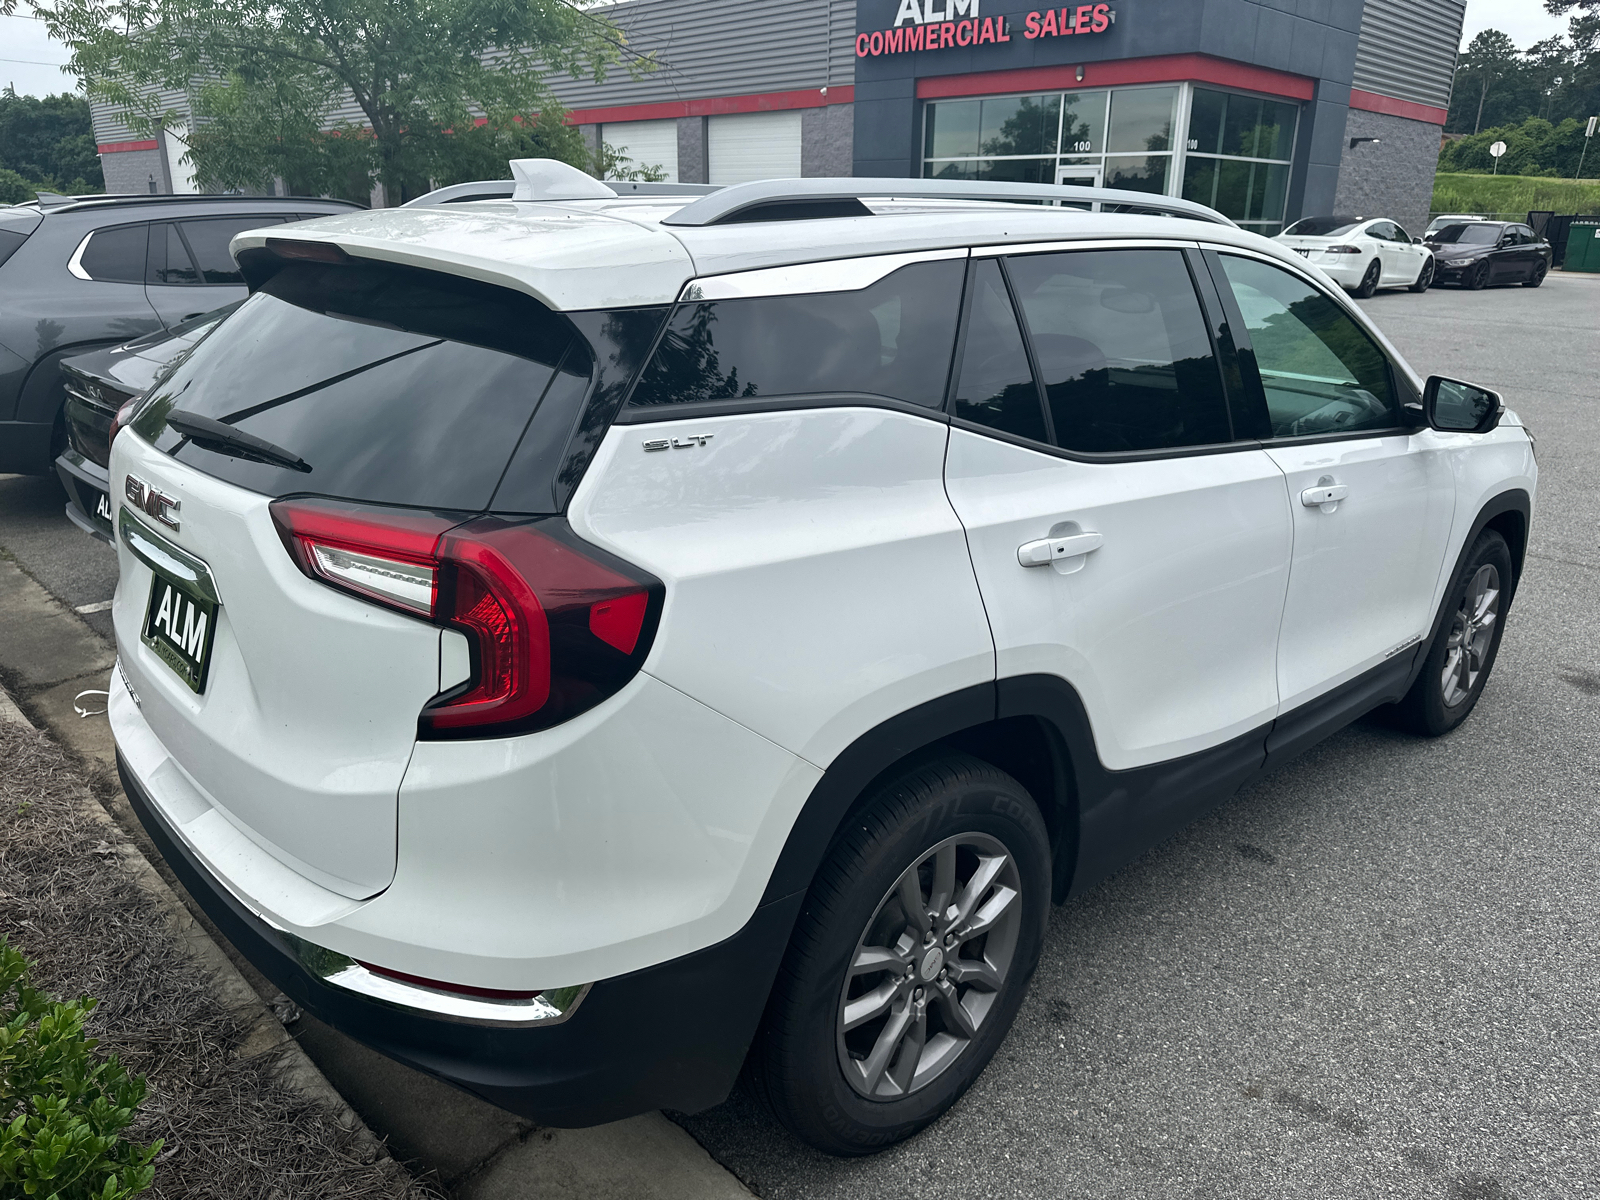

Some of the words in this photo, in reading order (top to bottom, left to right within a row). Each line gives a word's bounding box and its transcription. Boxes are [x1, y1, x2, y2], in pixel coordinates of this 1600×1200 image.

[893, 0, 979, 27] ALM
[855, 16, 1010, 58] COMMERCIAL
[1024, 3, 1110, 40] SALES
[1073, 140, 1091, 152] 100
[642, 433, 714, 453] SLT
[97, 494, 112, 521] AL
[125, 473, 181, 533] GMC
[155, 584, 208, 664] ALM
